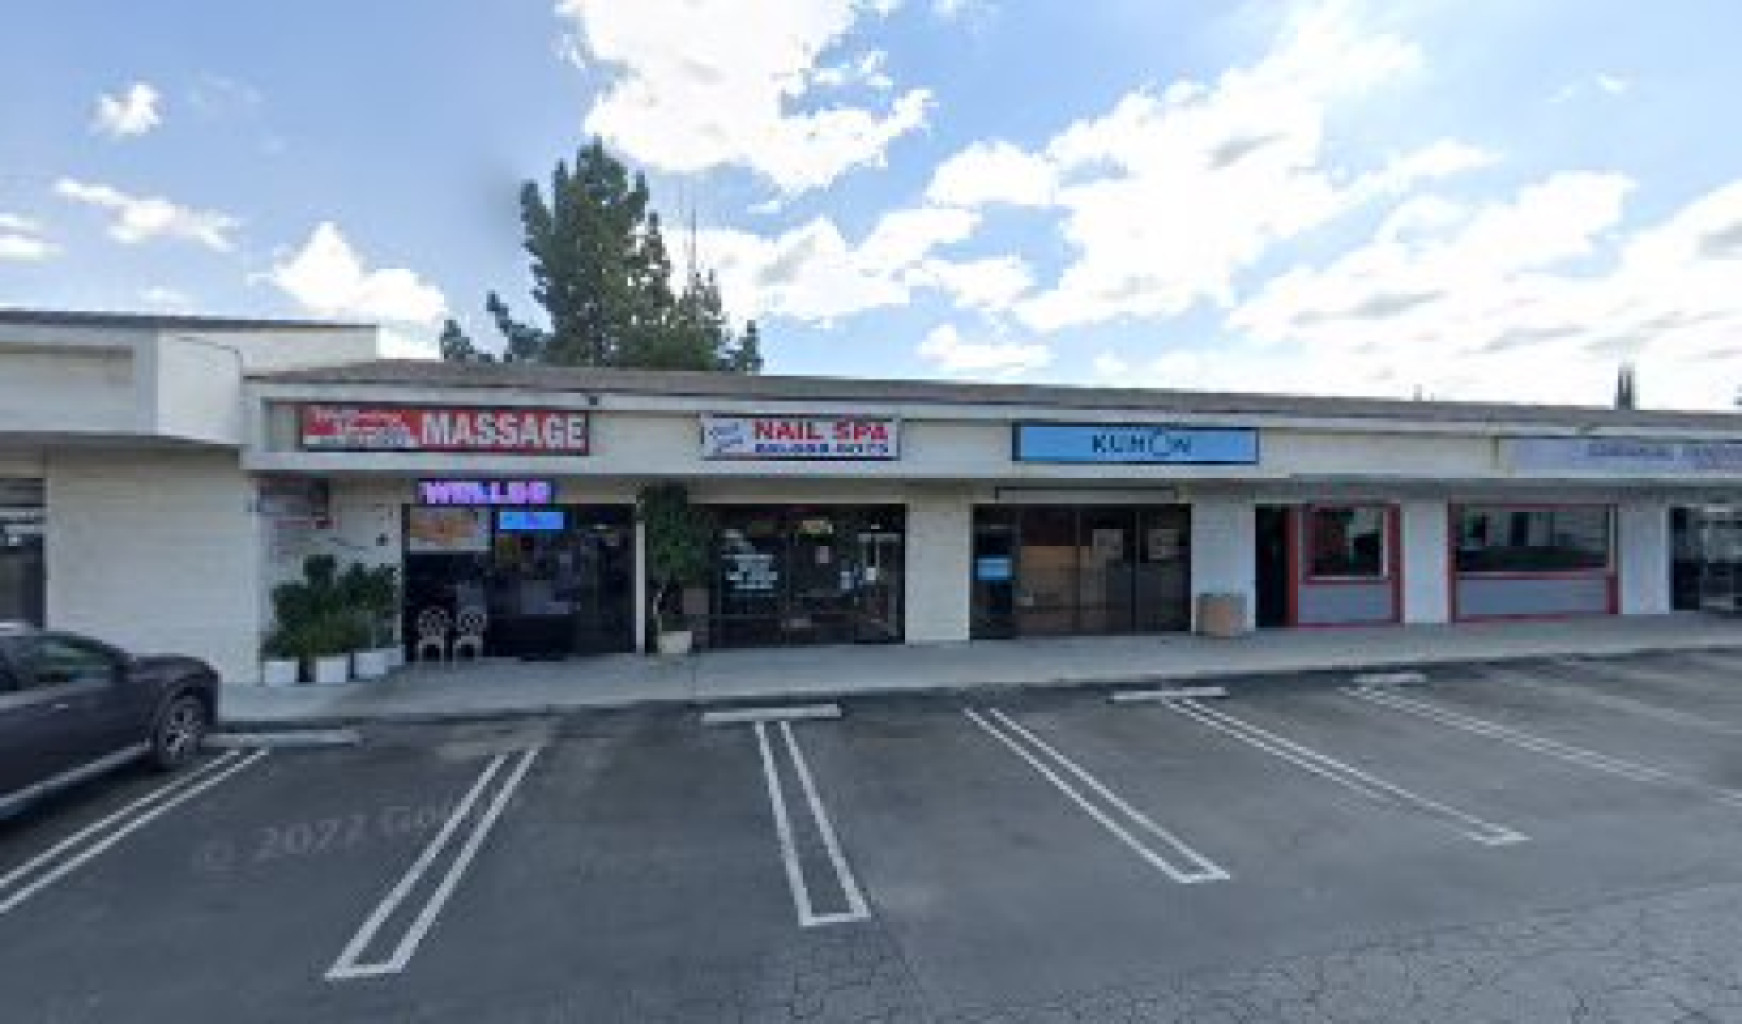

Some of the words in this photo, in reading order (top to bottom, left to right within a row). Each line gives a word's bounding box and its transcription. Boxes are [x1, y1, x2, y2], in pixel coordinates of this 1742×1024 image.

[421, 411, 586, 449] MASSAGE
[754, 420, 824, 440] NAIL
[833, 421, 889, 441] SPA
